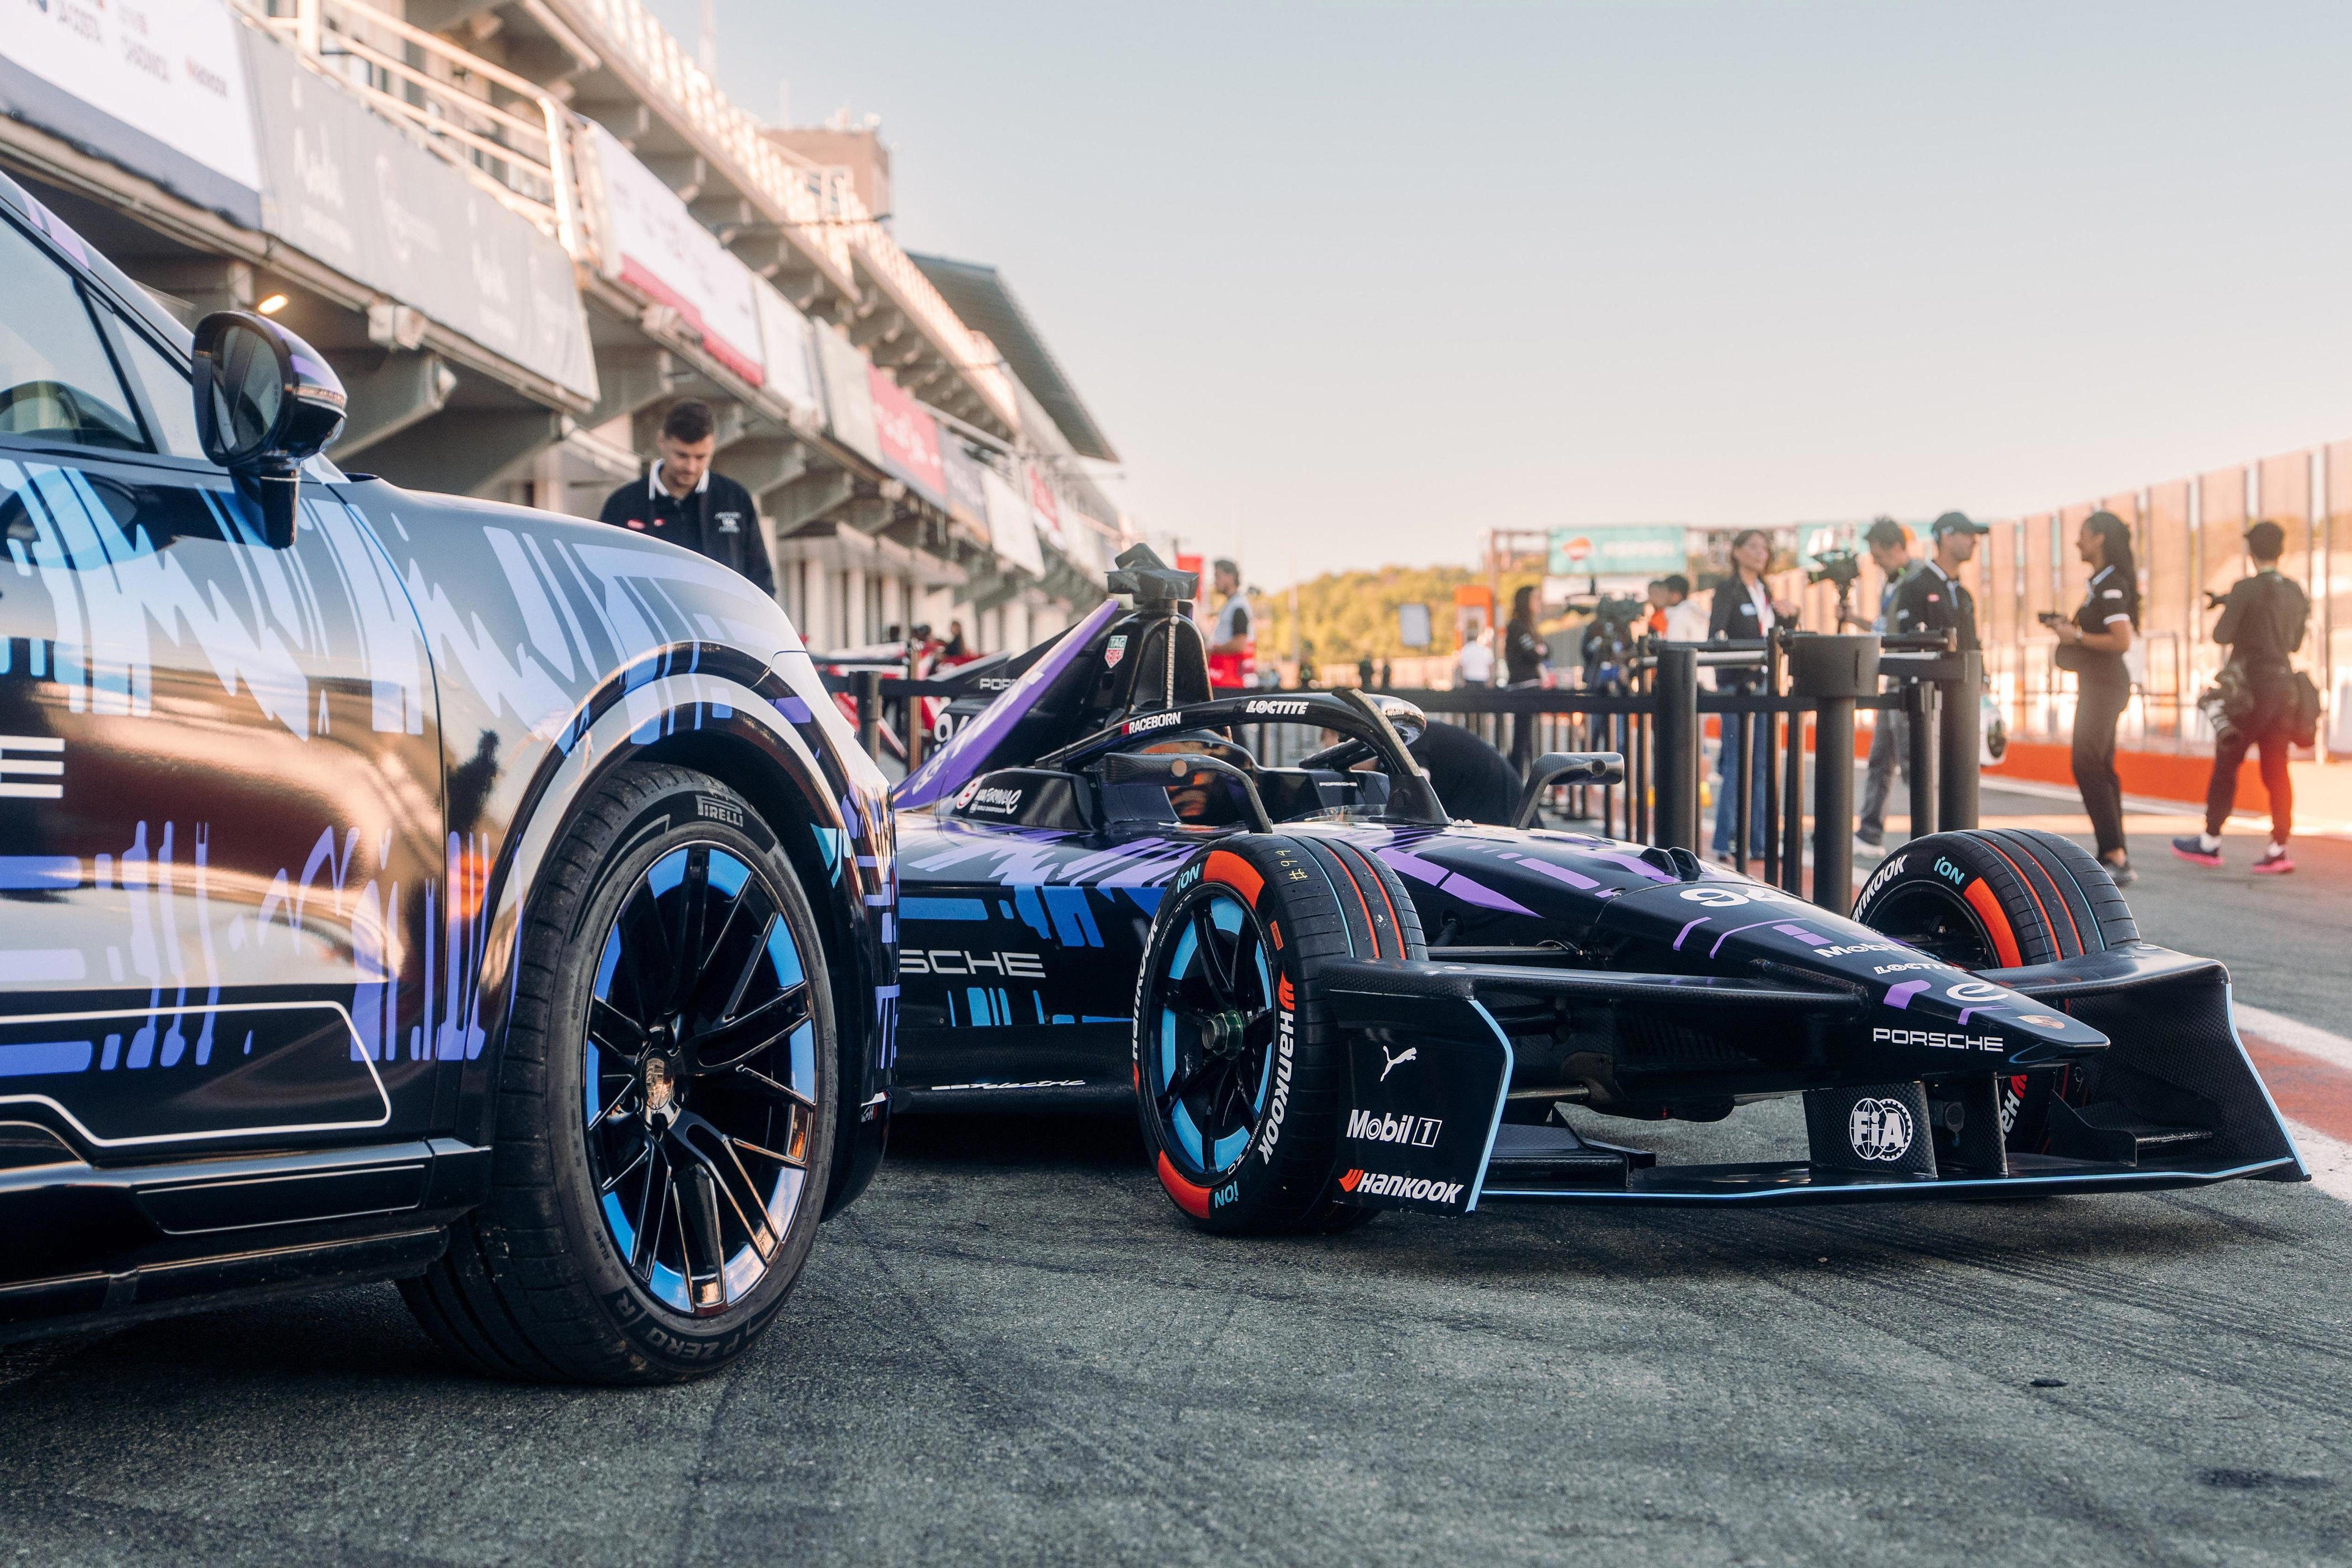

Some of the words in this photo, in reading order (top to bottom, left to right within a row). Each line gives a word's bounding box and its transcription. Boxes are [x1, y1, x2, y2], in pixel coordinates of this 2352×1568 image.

[1109, 638, 1125, 648] TAG
[1245, 700, 1310, 715] LOCTITE
[1128, 712, 1182, 734] RACEBORN
[695, 794, 743, 828] PIRELLI
[1812, 943, 1907, 958] Mobil
[1873, 963, 1967, 975] LOCTITE
[1873, 1028, 2004, 1052] PORSCHE
[1346, 1109, 1415, 1144] Mobil
[1227, 1154, 1245, 1175] OZ
[1247, 1120, 1262, 1150] RACING
[645, 1326, 720, 1359] ZERO
